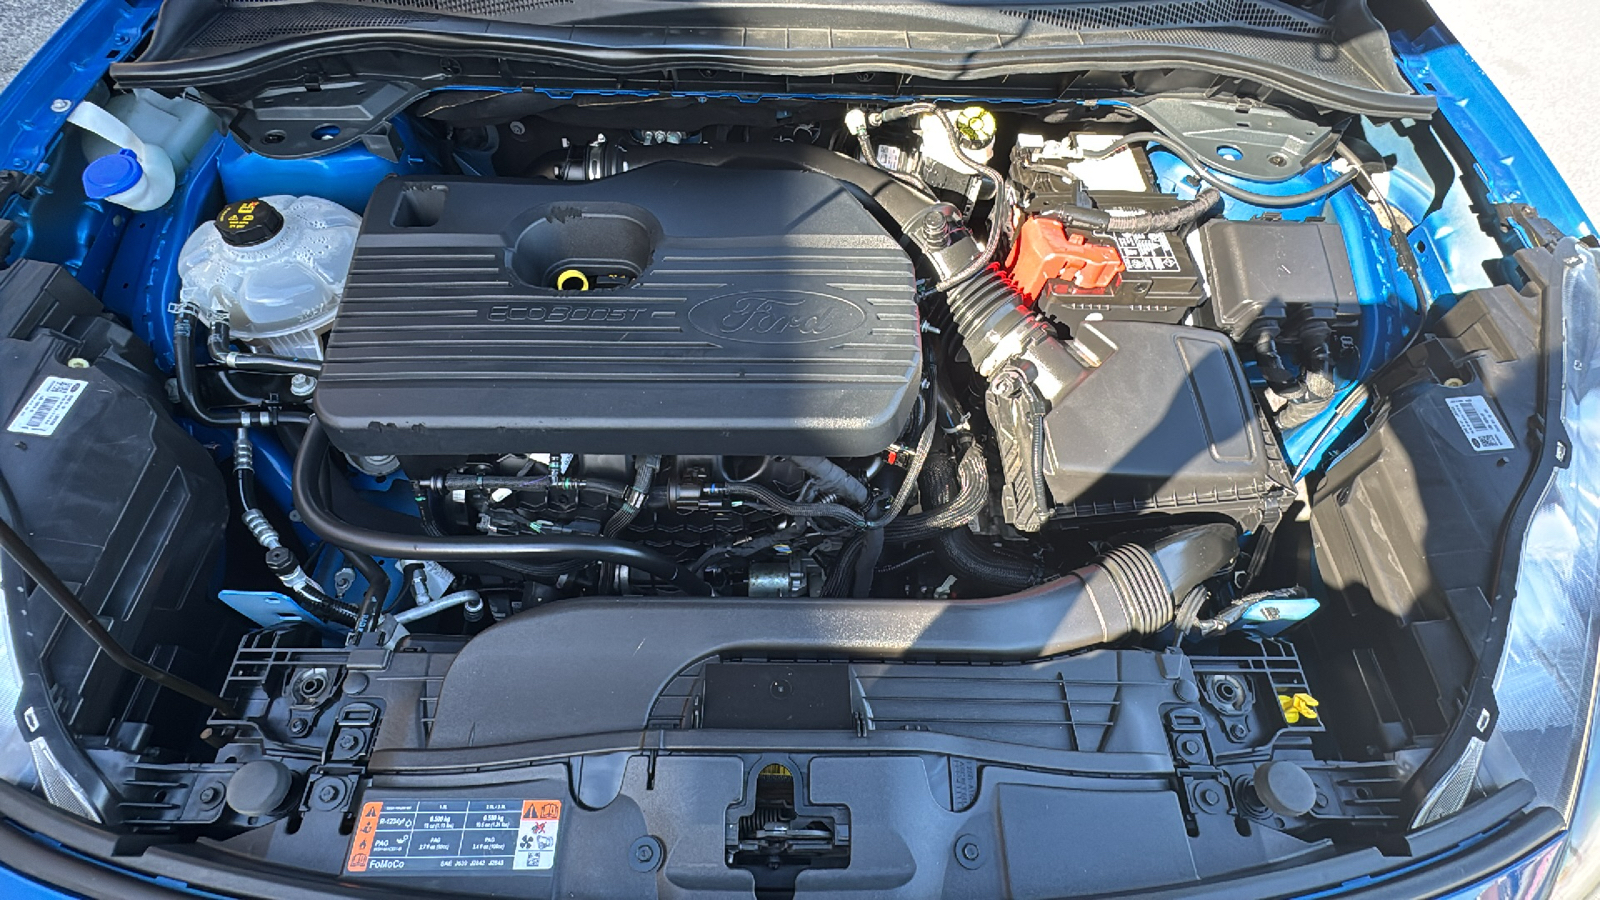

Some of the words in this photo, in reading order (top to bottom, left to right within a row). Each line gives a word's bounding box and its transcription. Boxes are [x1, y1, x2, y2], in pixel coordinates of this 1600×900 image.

[719, 296, 835, 335] Ford
[379, 817, 406, 826] R-1234yf
[374, 839, 389, 847] PAG
[369, 859, 405, 869] FoMoCo
